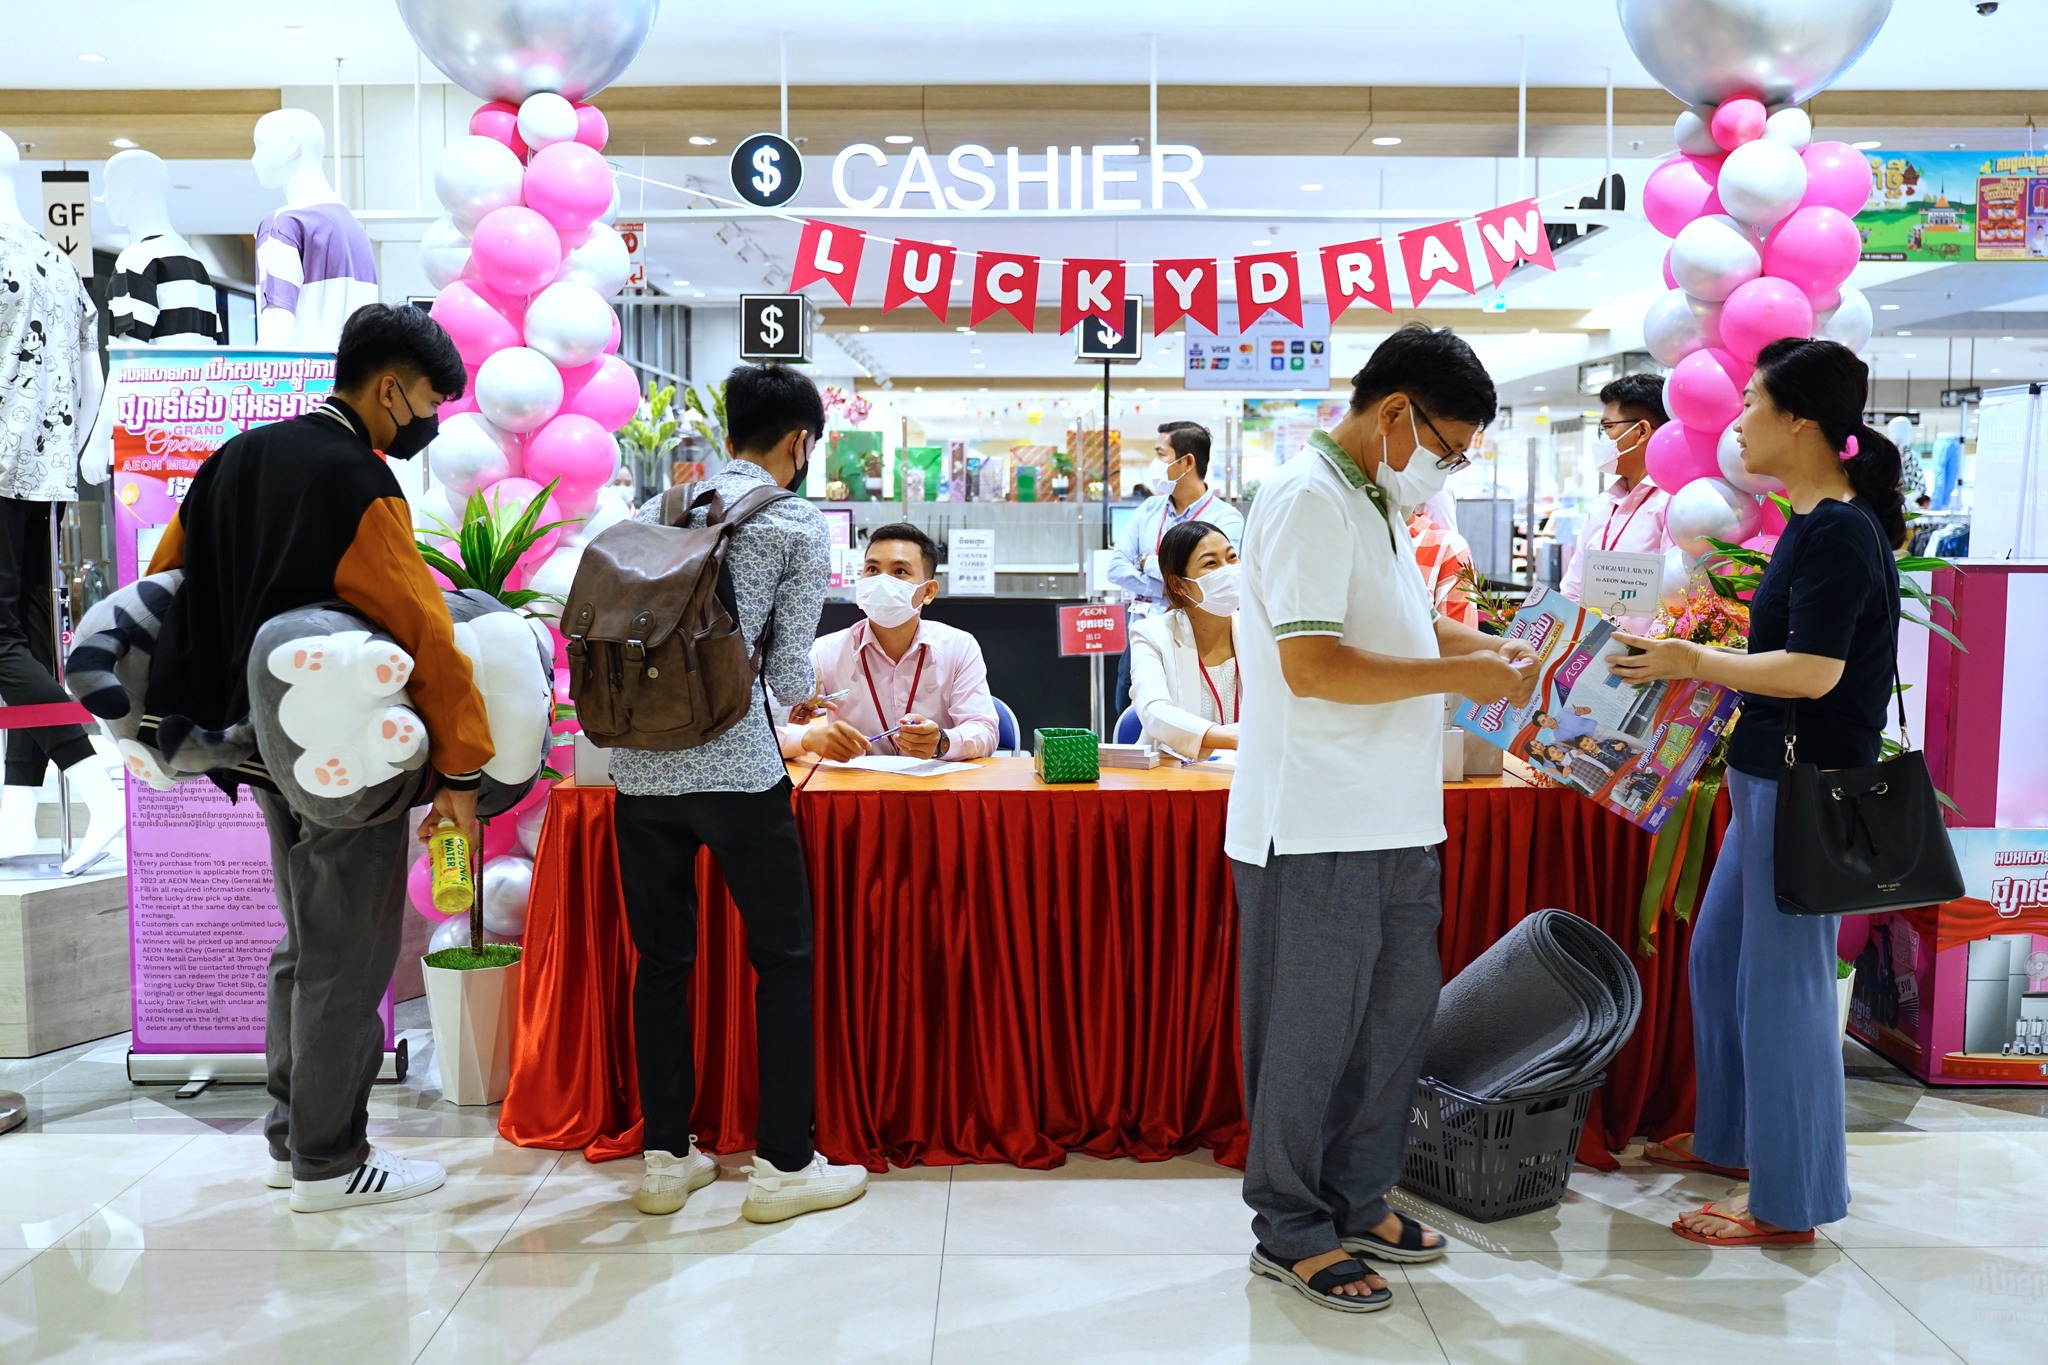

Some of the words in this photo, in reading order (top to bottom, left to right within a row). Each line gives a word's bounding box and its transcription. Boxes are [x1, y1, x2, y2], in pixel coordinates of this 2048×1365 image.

[832, 143, 1208, 211] CASHIER
[48, 203, 85, 226] GF
[174, 426, 224, 436] GRAND
[122, 460, 162, 471] AEON
[1593, 564, 1654, 575] CONGRATULATIONS
[445, 838, 456, 867] WATER
[139, 860, 157, 869] Every
[160, 860, 192, 869] purchase
[214, 860, 226, 869] 10$
[242, 860, 268, 869] receipt,
[156, 869, 193, 878] promotion
[203, 869, 240, 878] applicable
[212, 877, 229, 886] Chey
[232, 876, 261, 886] (General
[171, 886, 201, 895] required
[247, 886, 270, 895] clearly
[165, 895, 184, 904] lucky
[206, 895, 221, 904] pick
[156, 903, 180, 912] receipt
[141, 912, 176, 921] exchange.
[196, 921, 229, 930] exchange
[267, 921, 285, 930] lucky
[199, 938, 222, 947] picked
[185, 947, 203, 956] Chey
[205, 946, 234, 956] (General
[237, 955, 252, 964] 3pm
[237, 964, 264, 973] through
[231, 973, 248, 982] prize
[144, 981, 172, 990] bringing
[174, 981, 194, 990] Lucky
[241, 981, 256, 990] Slip,
[144, 989, 174, 999] (original)
[207, 990, 223, 999] legal
[144, 998, 164, 1007] Lucky
[212, 1016, 229, 1025] right
